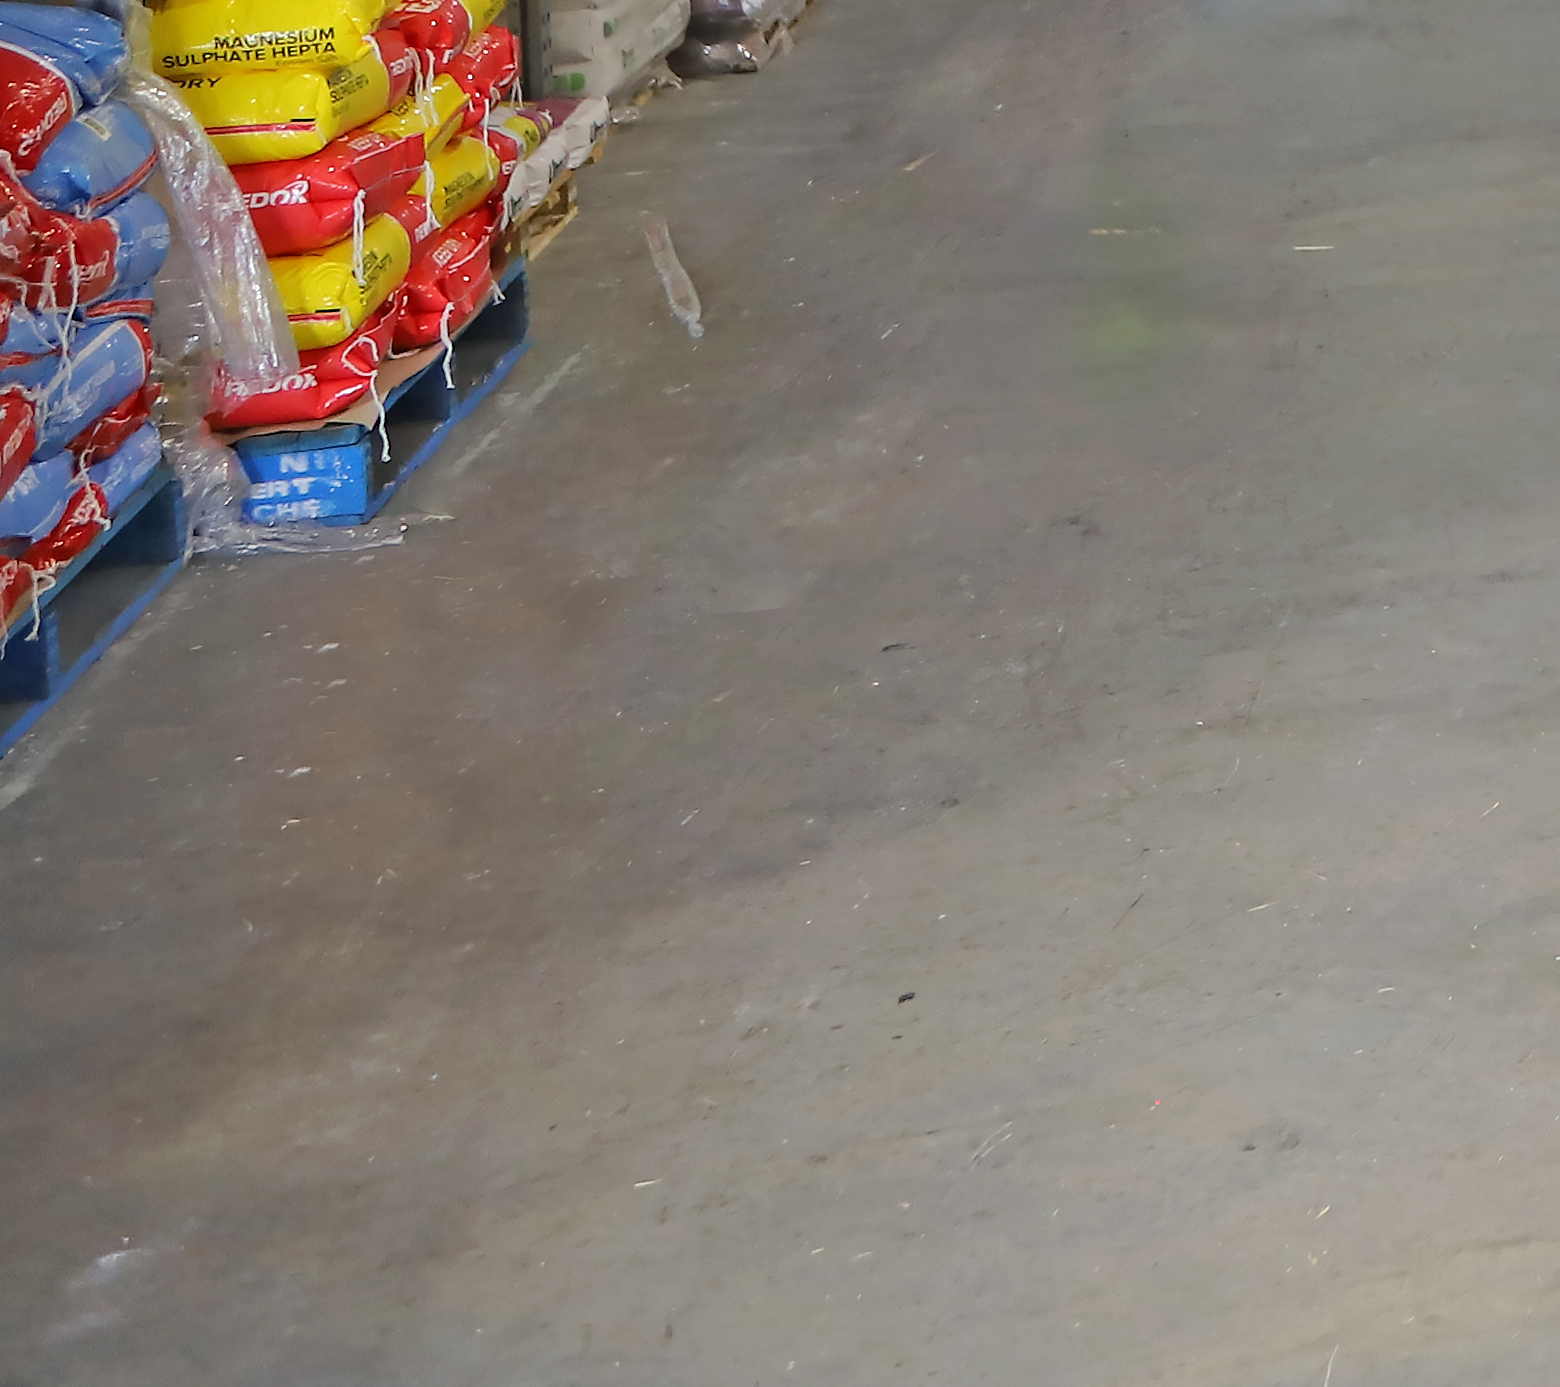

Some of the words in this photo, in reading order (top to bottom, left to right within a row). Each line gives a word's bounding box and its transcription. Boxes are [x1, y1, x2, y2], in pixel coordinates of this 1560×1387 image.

[213, 26, 335, 50] MAGNESIUM
[162, 47, 267, 69] SULPHATE
[272, 41, 337, 60] HEPTA
